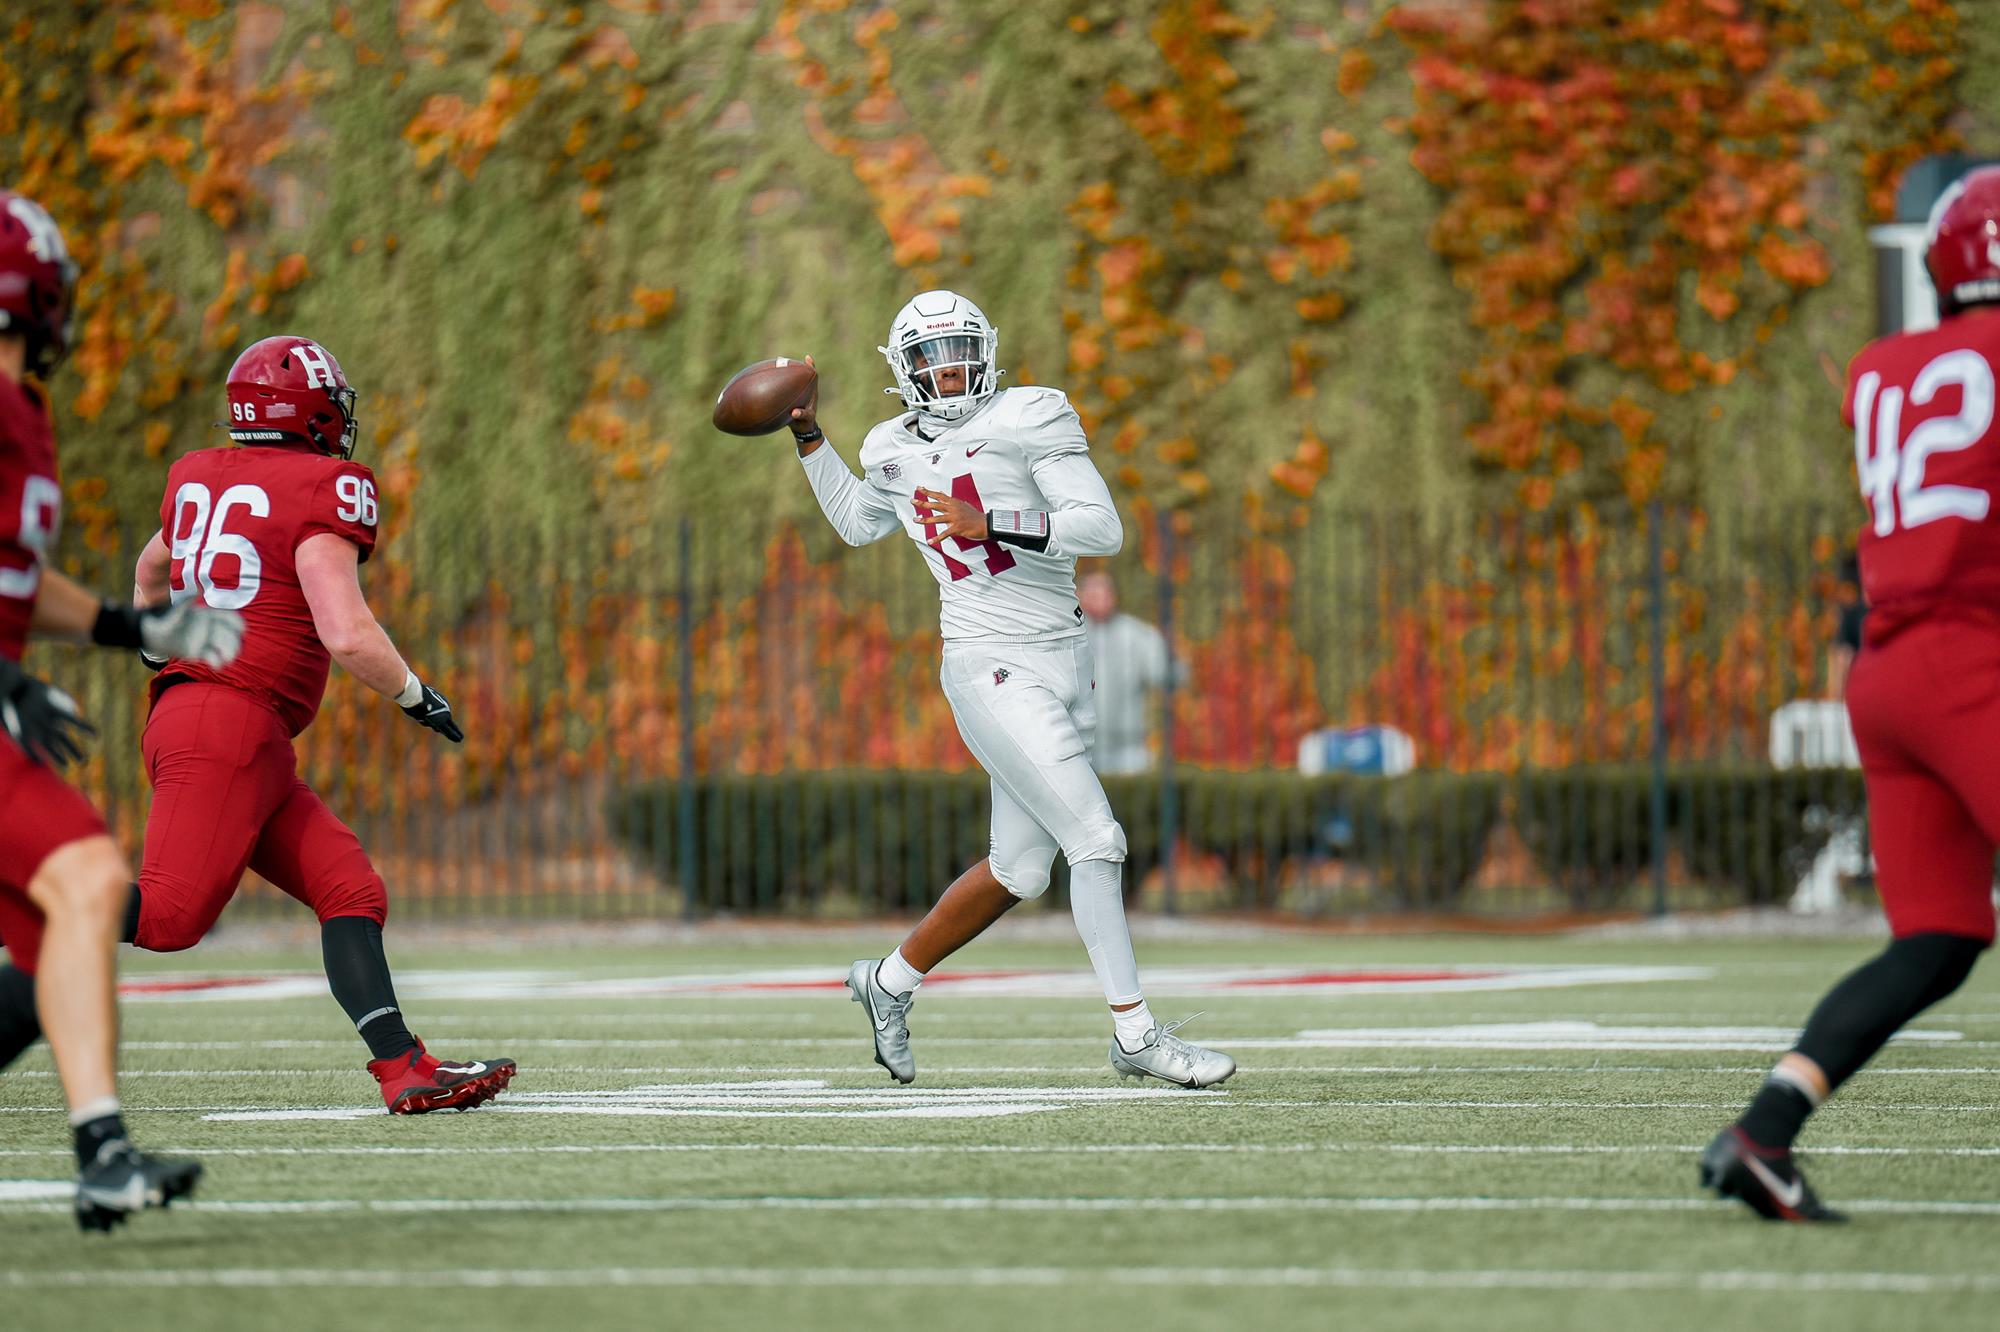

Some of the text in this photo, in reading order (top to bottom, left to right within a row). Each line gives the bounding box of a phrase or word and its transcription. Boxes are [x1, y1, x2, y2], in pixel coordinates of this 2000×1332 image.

[926, 321, 955, 329] Riddell
[289, 345, 337, 390] H
[232, 402, 256, 422] 96
[1853, 349, 1996, 538] 42
[335, 474, 378, 527] 96
[169, 481, 271, 611] 96
